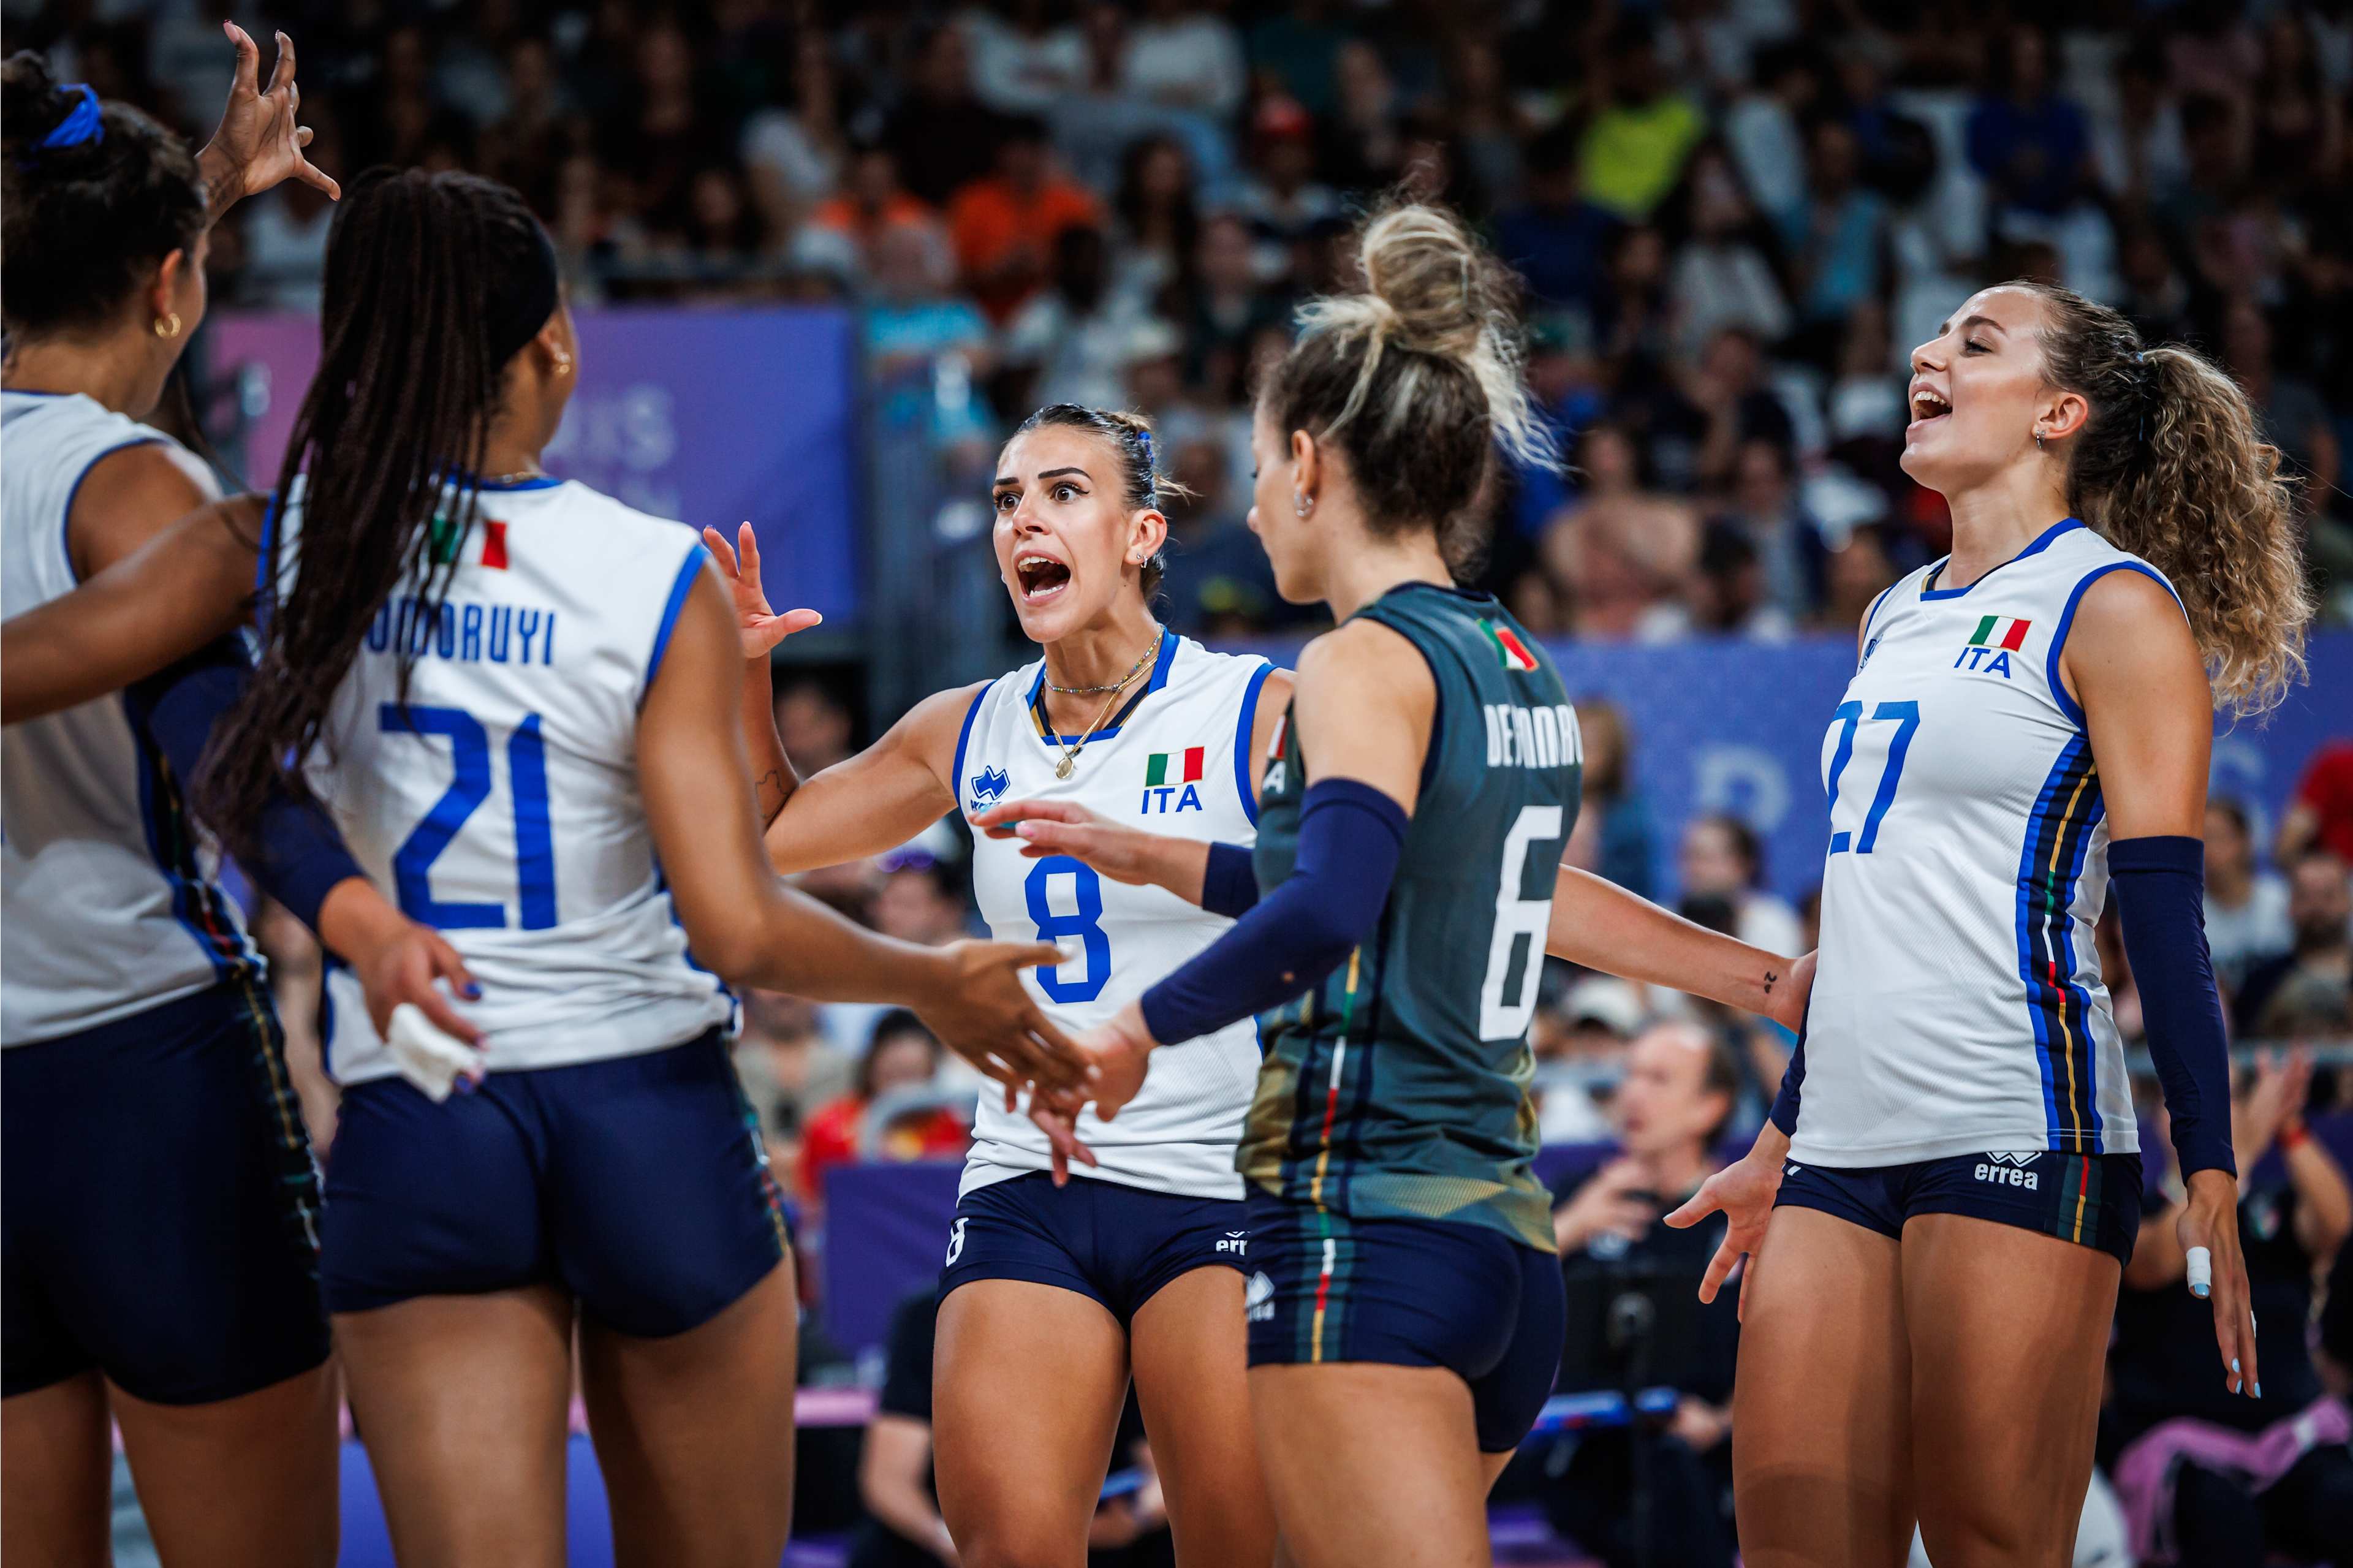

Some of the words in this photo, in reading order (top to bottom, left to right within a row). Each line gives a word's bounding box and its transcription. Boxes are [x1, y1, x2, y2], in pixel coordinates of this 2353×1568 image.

[1953, 647, 2010, 679] ITA
[379, 703, 557, 931] 21
[1142, 784, 1202, 814] ITA
[1828, 700, 1920, 858] 27
[1025, 854, 1111, 1004] 8
[1479, 805, 1563, 1042] 6
[945, 1217, 969, 1268] 8
[1215, 1239, 1248, 1256] err
